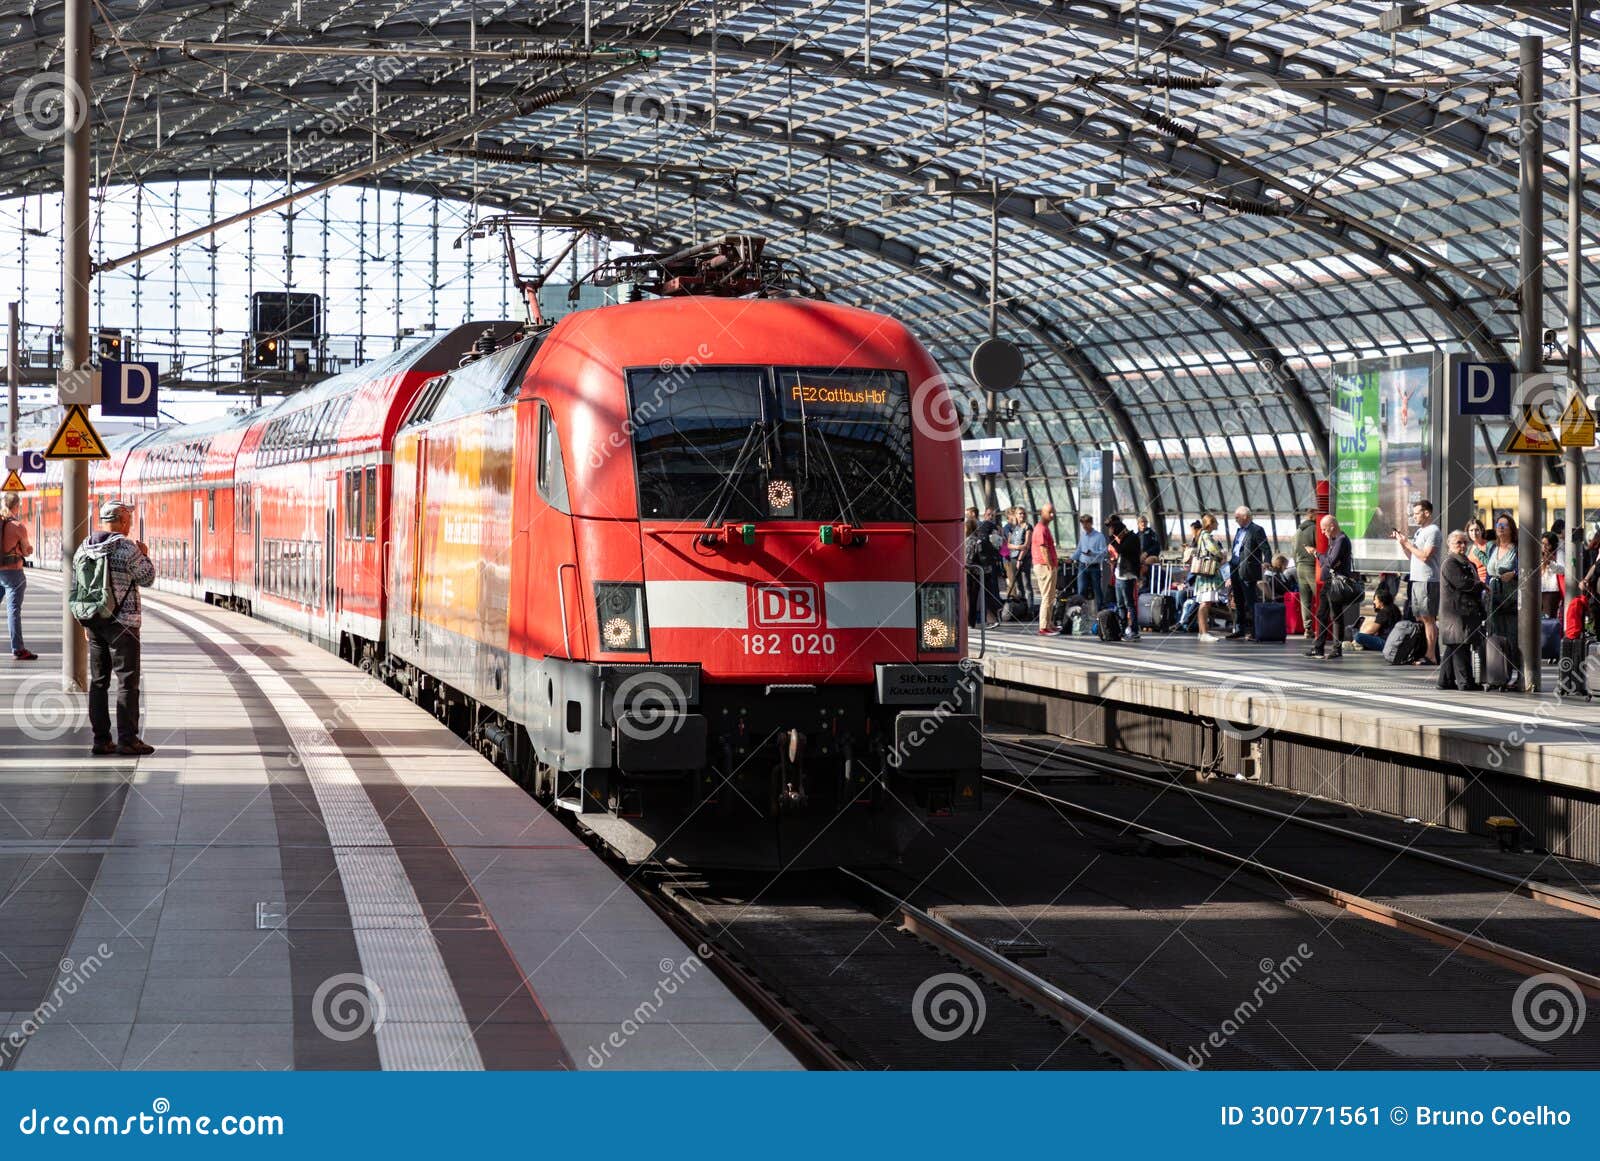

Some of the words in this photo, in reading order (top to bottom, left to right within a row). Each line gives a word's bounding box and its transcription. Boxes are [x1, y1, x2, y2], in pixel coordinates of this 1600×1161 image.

[121, 364, 152, 404] D
[818, 388, 864, 403] Cottbus
[865, 390, 886, 403] Hbf
[1467, 365, 1495, 403] D
[1341, 395, 1364, 421] MIT
[1340, 427, 1367, 453] UNS
[30, 453, 44, 469] C
[762, 590, 813, 620] DB
[741, 634, 781, 655] 182
[791, 634, 835, 655] 020
